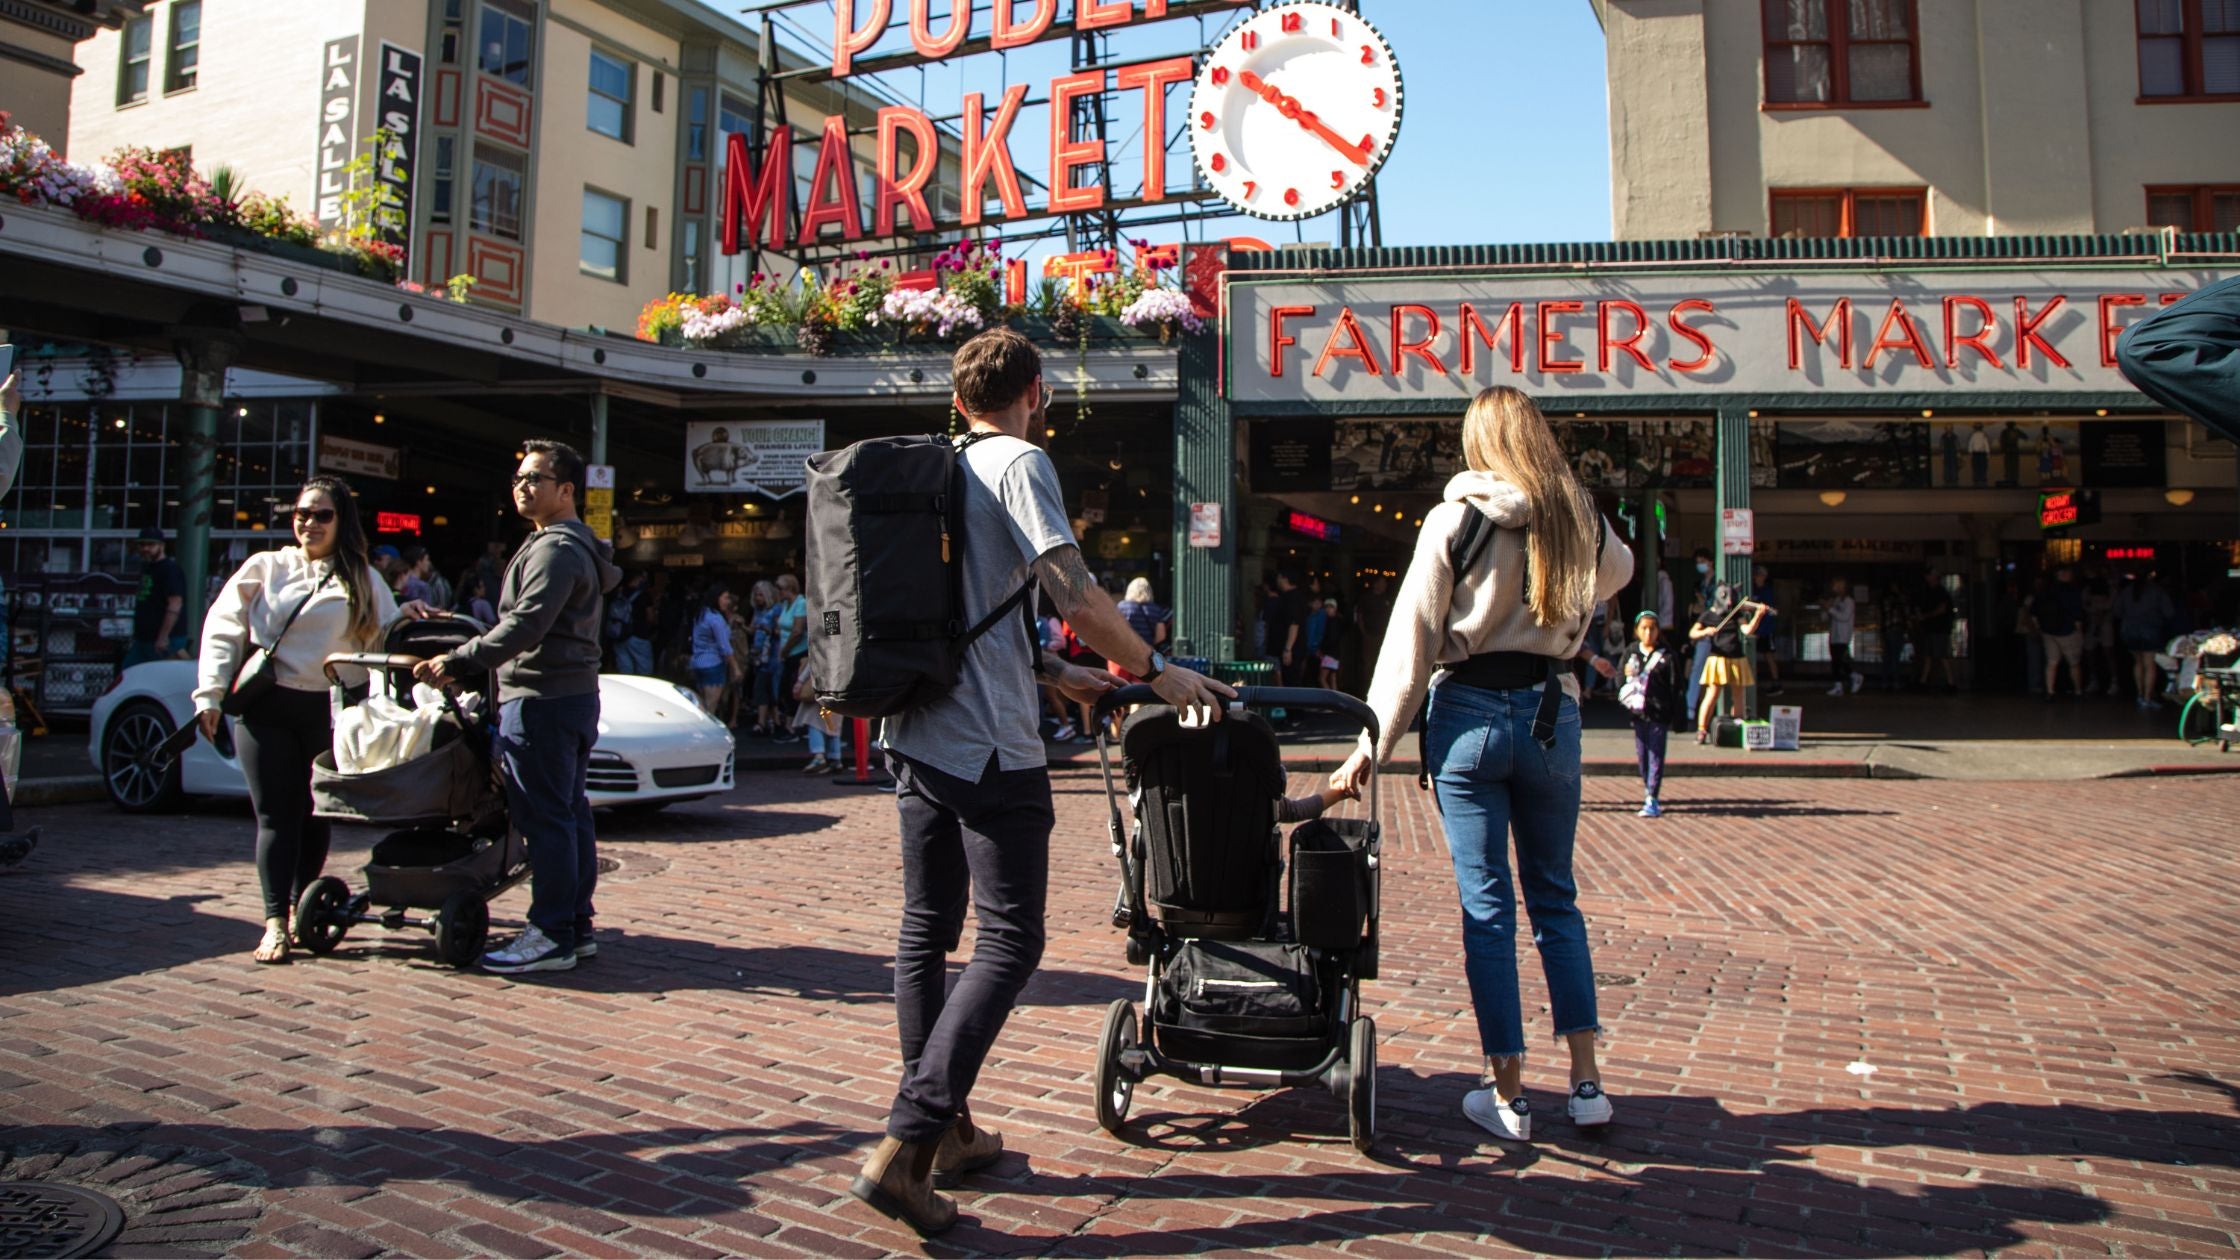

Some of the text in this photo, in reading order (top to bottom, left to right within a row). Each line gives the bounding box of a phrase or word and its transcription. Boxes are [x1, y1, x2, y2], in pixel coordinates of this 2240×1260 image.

[1282, 12, 1301, 32] 12
[1241, 30, 1256, 51] 11
[1360, 45, 1374, 64] 2
[386, 50, 413, 102] LA
[1211, 66, 1229, 86] 10
[1372, 87, 1385, 108] 3
[1200, 111, 1215, 130] 9
[319, 43, 352, 221] LA SALLE
[721, 56, 1195, 255] MARKET
[1331, 170, 1344, 190] 5
[1242, 181, 1256, 200] 7
[1284, 187, 1299, 207] 6
[1269, 293, 2192, 377] FARMERS MARKE
[1841, 538, 1915, 553] BAKERY
